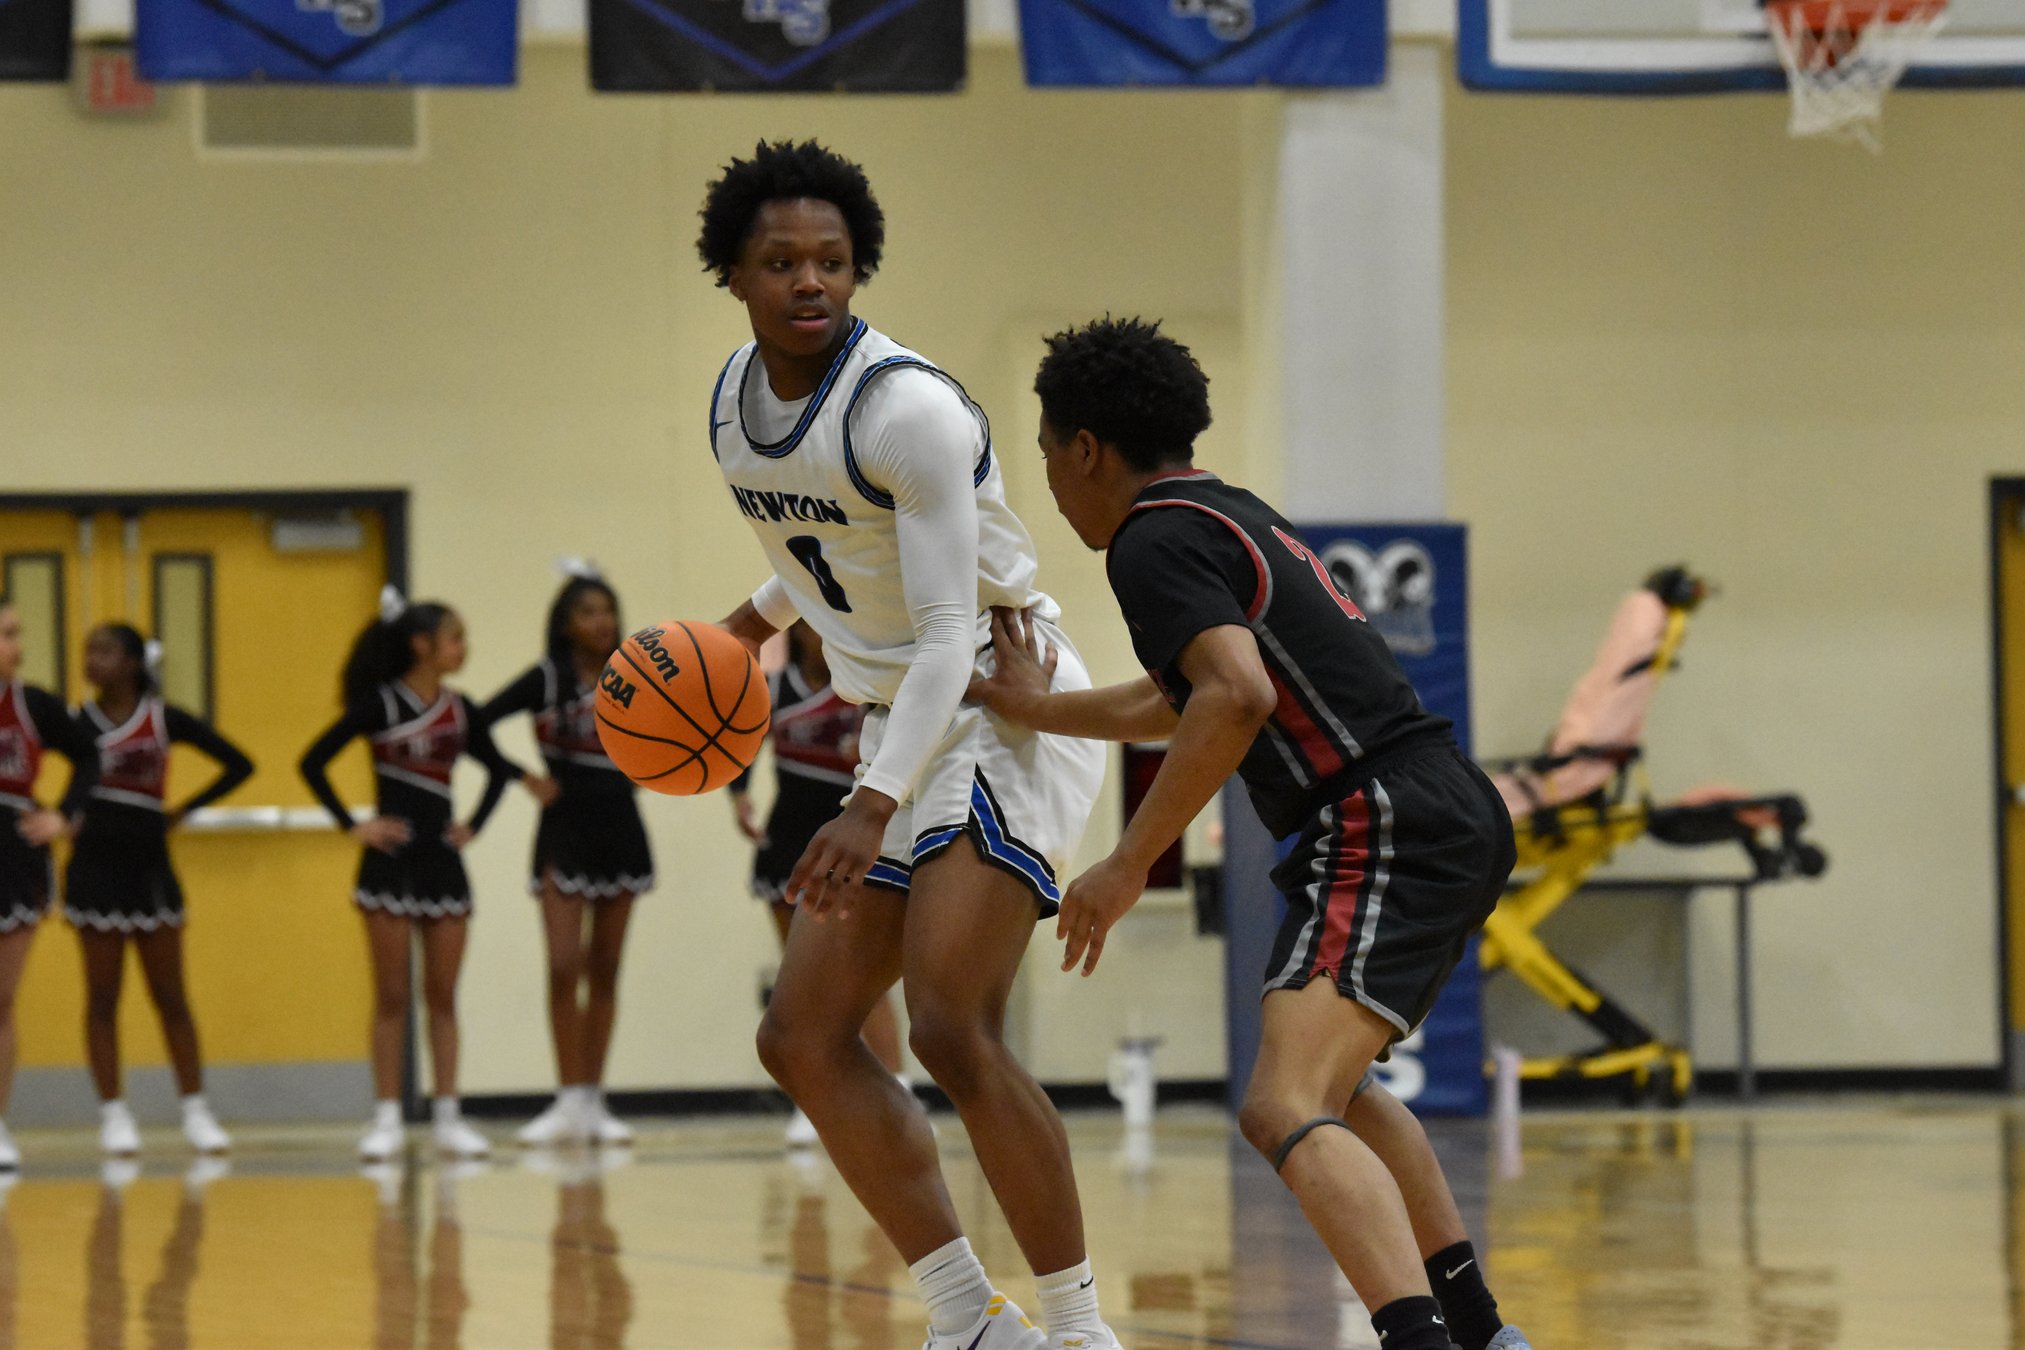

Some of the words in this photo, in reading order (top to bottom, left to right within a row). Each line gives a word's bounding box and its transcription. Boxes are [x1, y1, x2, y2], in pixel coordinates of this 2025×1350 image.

[730, 484, 849, 526] NEWTON
[785, 535, 853, 614] 0
[1270, 525, 1367, 623] 2
[600, 664, 637, 709] CAA
